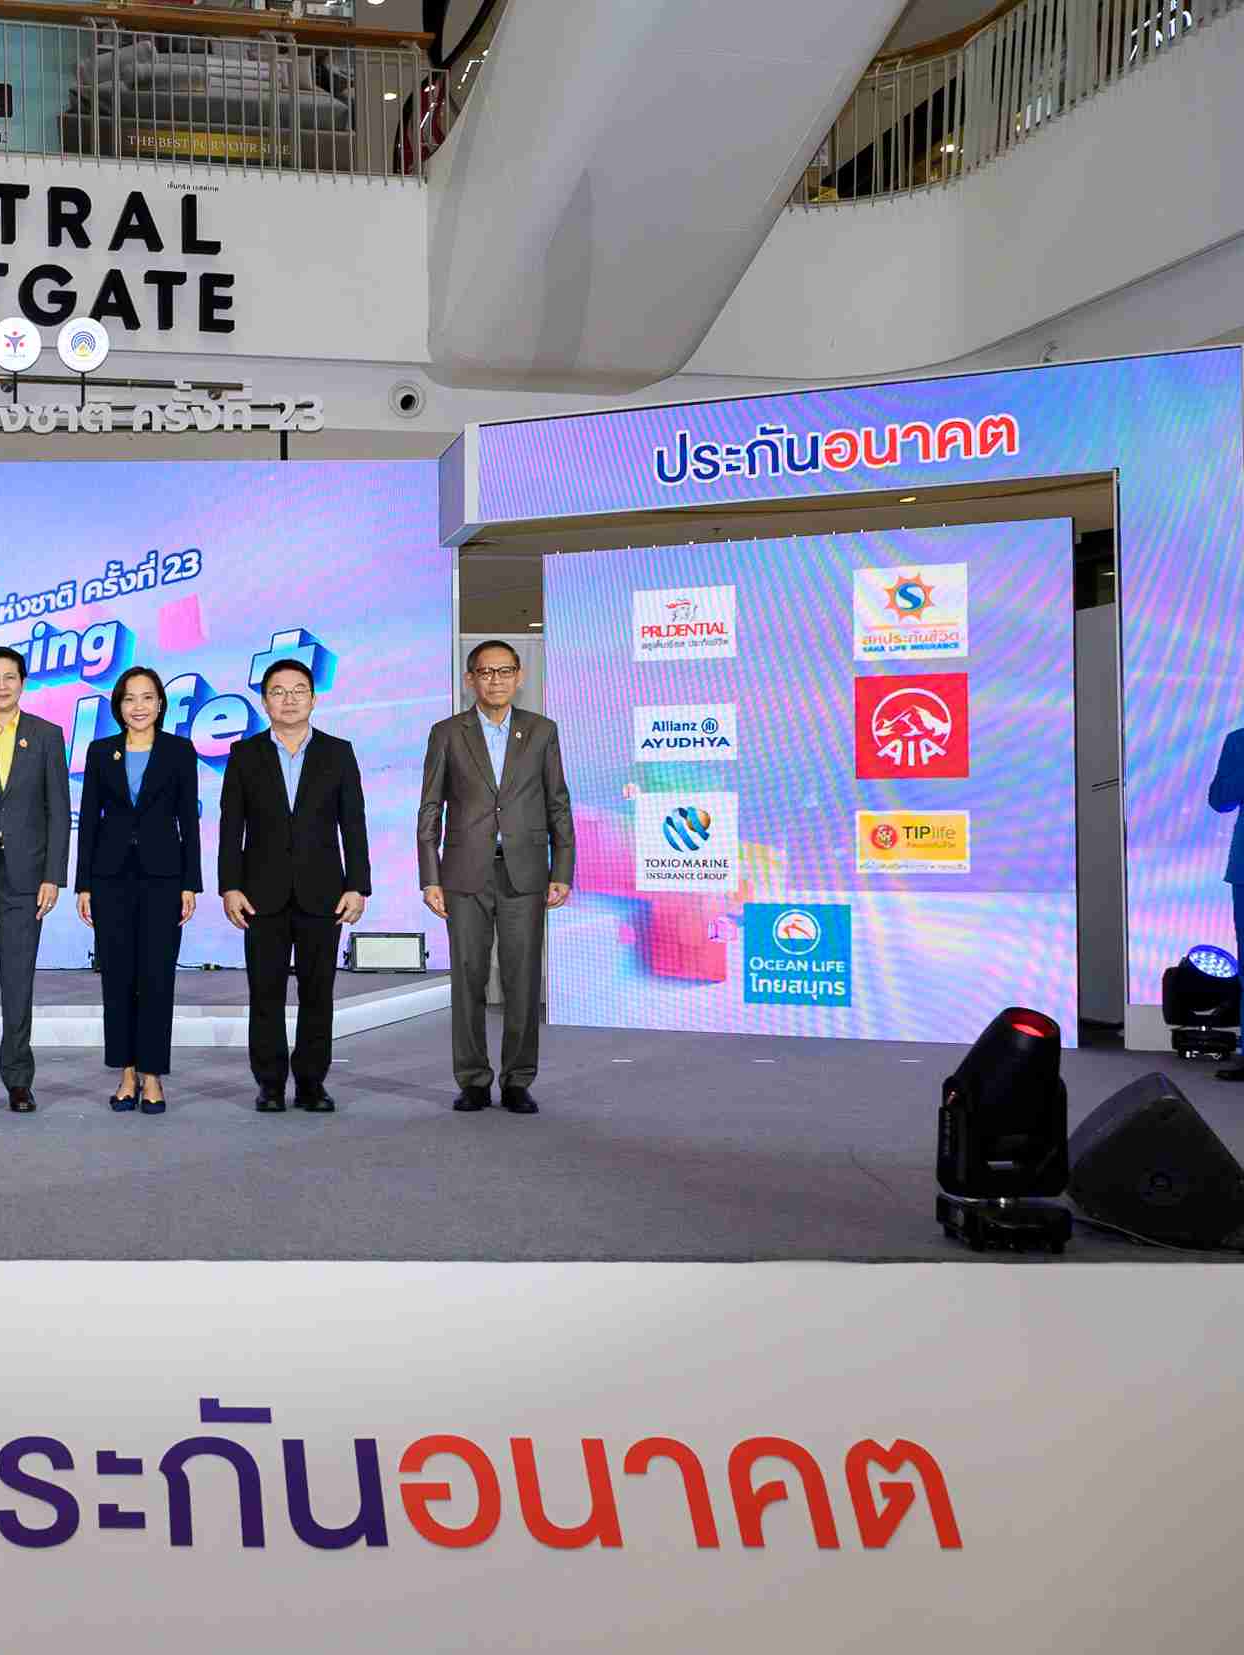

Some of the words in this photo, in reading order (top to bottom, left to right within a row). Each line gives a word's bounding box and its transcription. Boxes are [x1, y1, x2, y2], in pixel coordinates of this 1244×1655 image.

[269, 395, 324, 432] 23
[655, 414, 1018, 483] ประกันอนาคต
[84, 552, 157, 602] ครั้งที่
[162, 549, 202, 584] 23
[641, 622, 729, 639] PRUDENTIAL
[652, 720, 698, 732] Allianz
[641, 736, 731, 749] AYUDHYA
[876, 737, 947, 767] AIA
[645, 859, 680, 869] TOKIO
[682, 859, 729, 868] MARINE
[646, 871, 695, 881] INSURANCE
[697, 872, 727, 881] GROUP
[749, 956, 807, 972] OCEAN
[749, 972, 846, 1000] ไทยสมุทร
